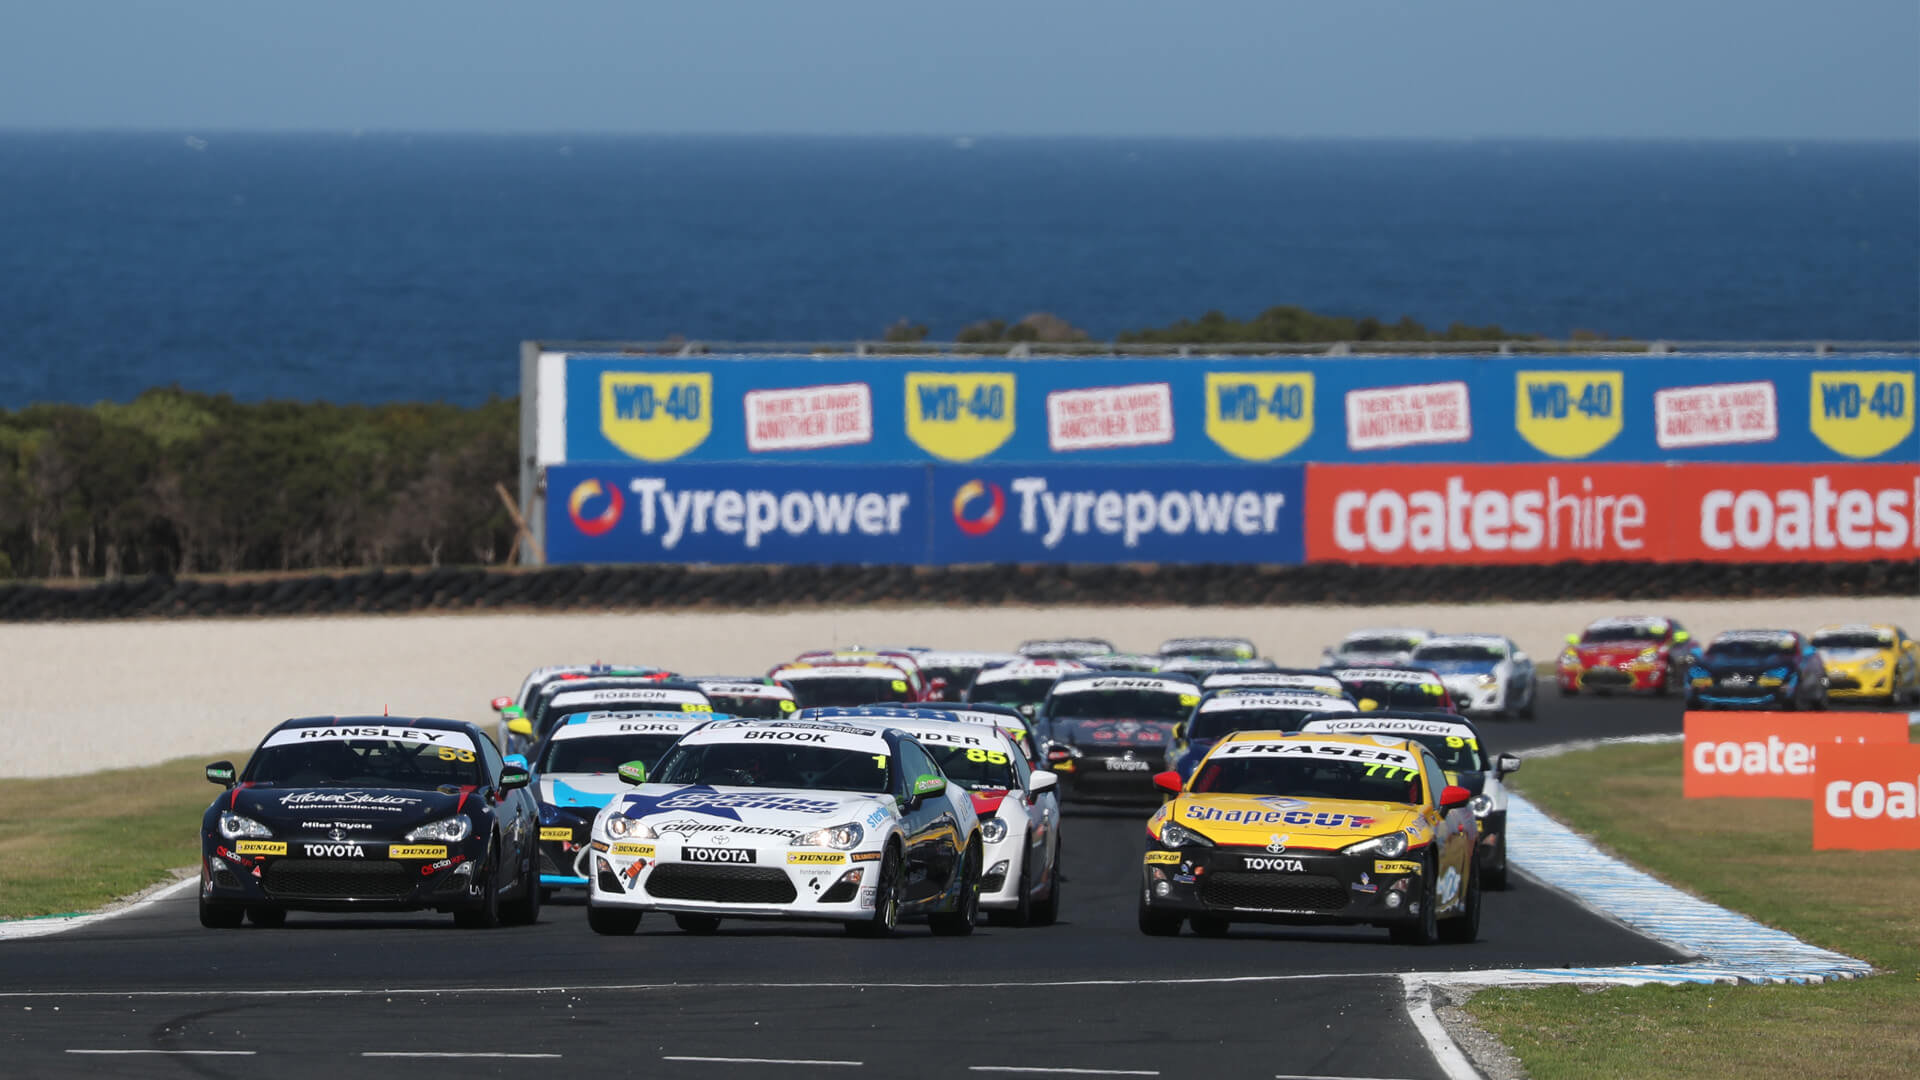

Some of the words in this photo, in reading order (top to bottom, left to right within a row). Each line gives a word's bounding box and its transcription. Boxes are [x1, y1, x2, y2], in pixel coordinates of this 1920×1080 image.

[612, 384, 701, 421] WD-40
[917, 384, 1005, 421] WD-40
[1217, 383, 1304, 421] WD-40
[1527, 382, 1613, 419] WD-40
[1821, 382, 1905, 419] WD-40
[630, 477, 907, 549] Tyrepower
[1012, 477, 1285, 549] Tyrepower
[593, 691, 667, 699] ROBSON
[1240, 698, 1324, 707] THOMAS
[619, 724, 680, 732] BORG
[1326, 721, 1451, 733] VODANOVICH
[300, 728, 444, 742] RANSLEY
[744, 731, 830, 743] BROOK
[1446, 736, 1479, 751] 91
[438, 746, 476, 763] 53
[967, 748, 1007, 765] 85
[1226, 744, 1407, 764] FRASER
[872, 755, 886, 769] 1
[1362, 762, 1420, 783] 777
[1825, 774, 1920, 819] coa
[302, 821, 332, 829] Miles
[334, 821, 373, 830] Toyota
[243, 844, 286, 852] DUNLOP
[303, 844, 365, 857] TOYOTA
[617, 845, 654, 854] DUNLOP
[688, 848, 751, 863] TOYOTA
[799, 854, 845, 862] DUNLOP
[1148, 854, 1180, 862] DUNLOP
[1243, 857, 1304, 872] TOYOTA
